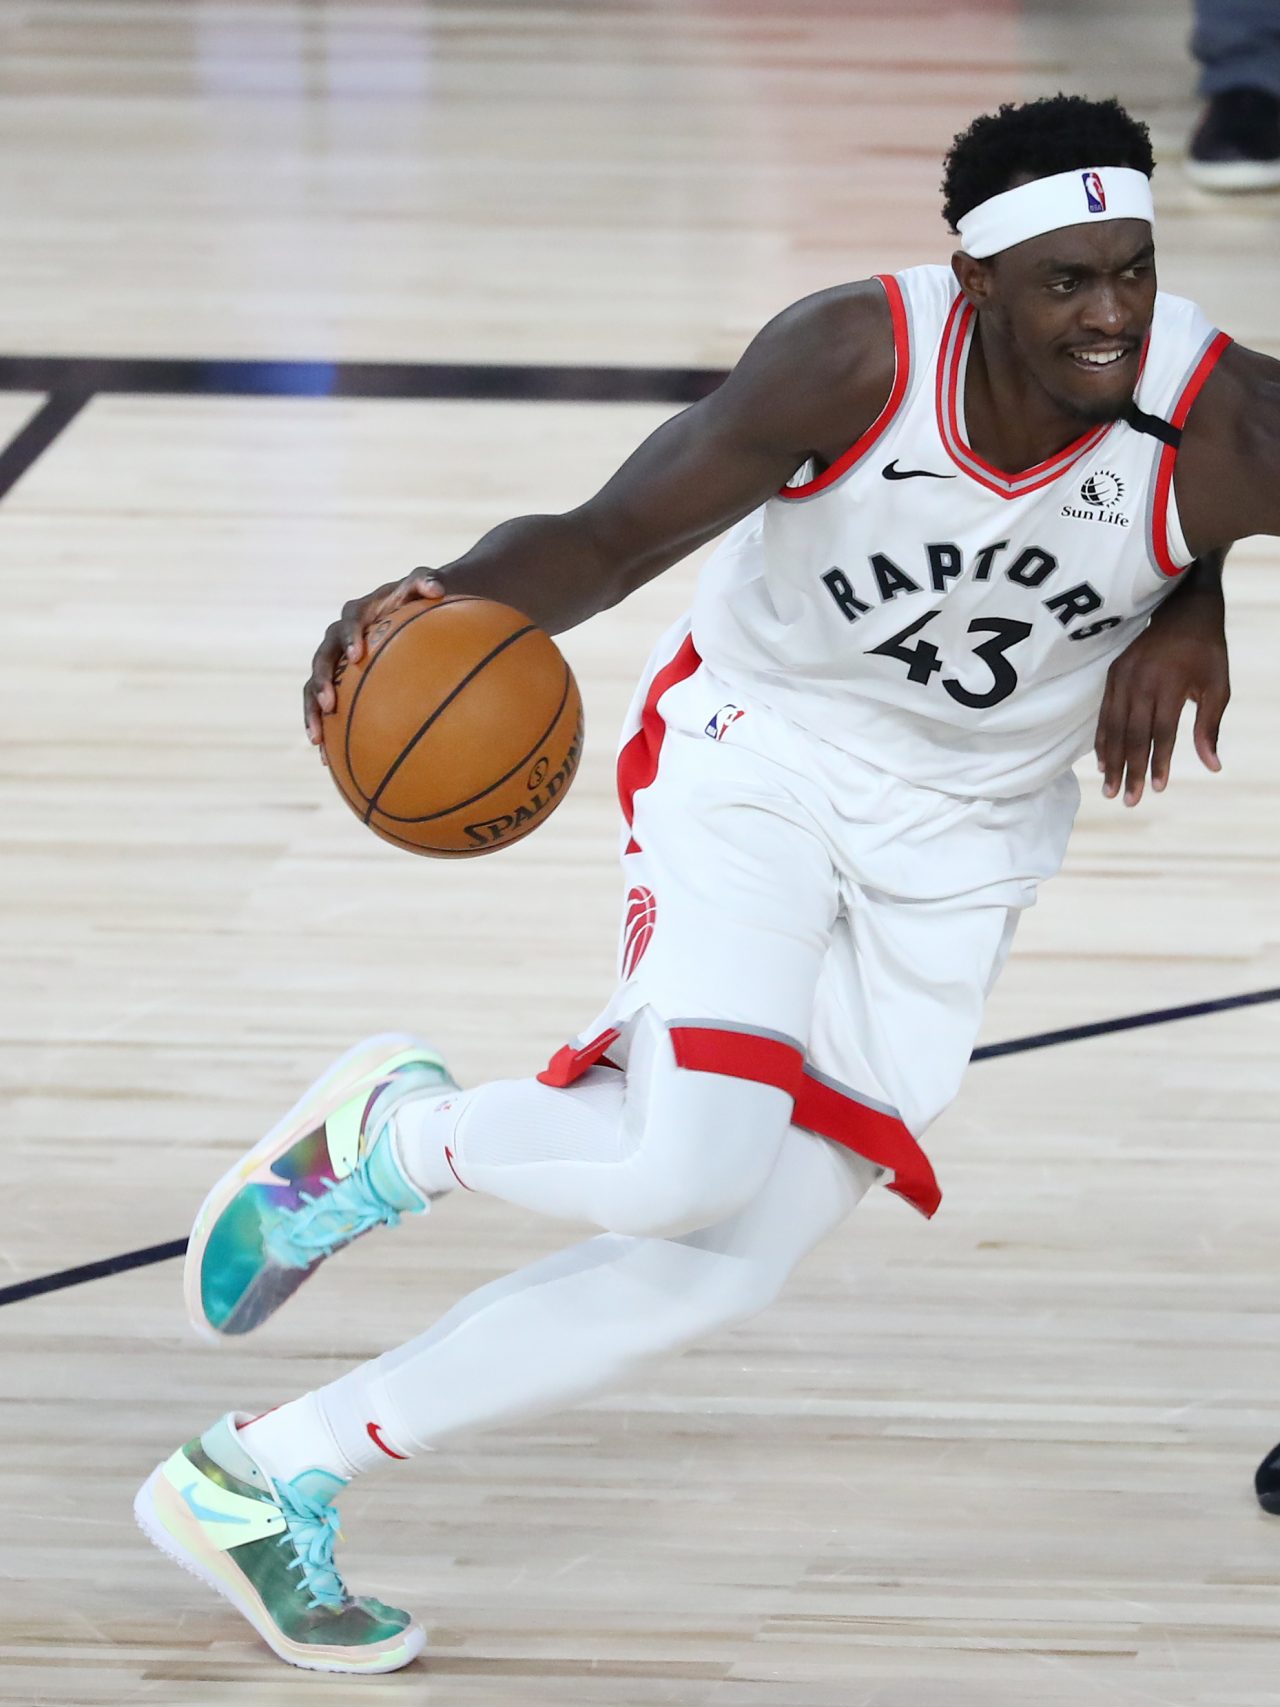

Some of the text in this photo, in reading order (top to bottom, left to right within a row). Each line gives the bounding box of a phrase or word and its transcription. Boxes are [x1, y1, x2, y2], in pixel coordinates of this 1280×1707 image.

[1060, 505, 1130, 527] Sun Life
[819, 539, 1121, 642] RAPTORS
[863, 610, 1033, 709] 43
